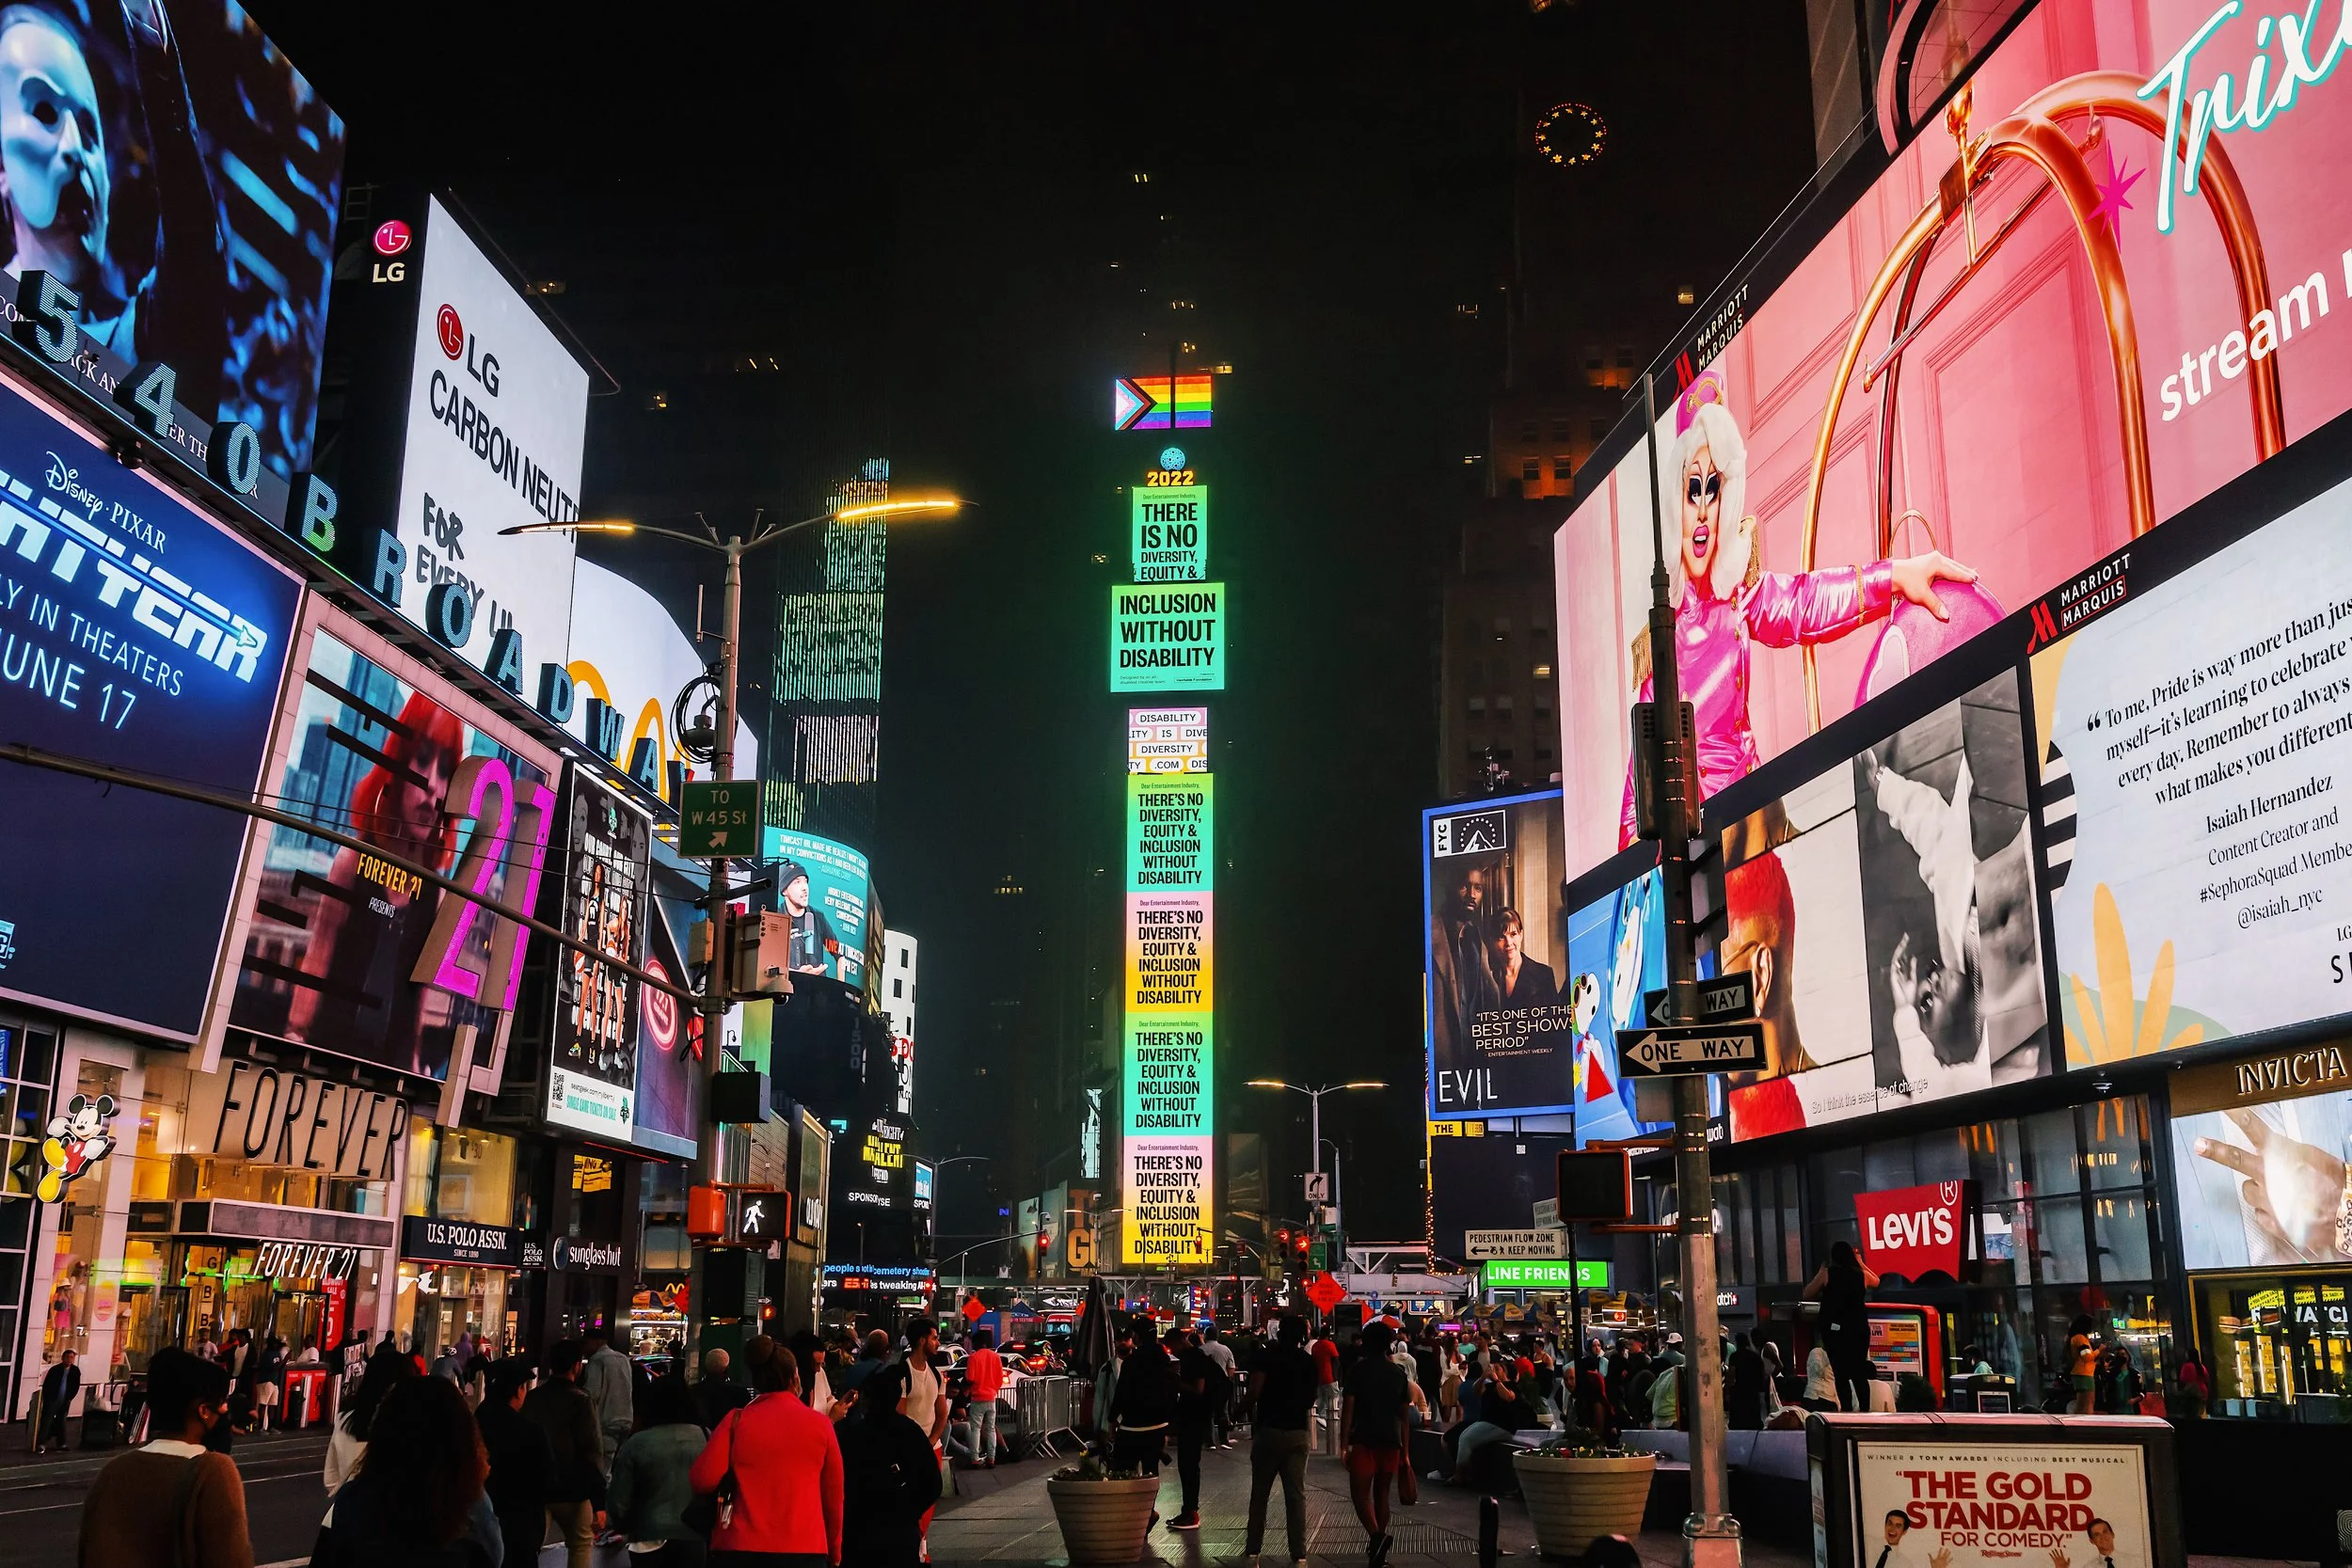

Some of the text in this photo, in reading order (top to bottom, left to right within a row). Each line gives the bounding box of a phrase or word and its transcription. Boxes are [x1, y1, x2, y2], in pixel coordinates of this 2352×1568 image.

[2137, 0, 2352, 234] Trix
[373, 262, 405, 283] LG
[1697, 284, 1748, 351] MARRIOTT
[1698, 313, 1743, 372] MARQUIS
[2160, 270, 2329, 421] stream
[467, 333, 500, 398] LG
[429, 370, 519, 490] CARBON
[1147, 470, 1194, 487] 2022
[1141, 502, 1198, 522] THERE
[110, 501, 167, 554] PIXAR
[424, 492, 464, 561] FOR
[1141, 523, 1198, 548] IS NO
[1141, 550, 1198, 563] DIVERSITY,
[1140, 564, 1198, 581] EQUITY &
[2061, 553, 2131, 607] MARRIOTT
[1120, 594, 1216, 614] INCLUSION
[2062, 578, 2126, 628] MARQUIS
[1120, 620, 1216, 642] WITHOUT
[29, 593, 184, 697] IN THEATERS
[1120, 647, 1215, 668] DISABILITY
[2106, 598, 2352, 729] To me, Pride is way more than jus
[0, 627, 136, 730] UNE 17
[2185, 641, 2346, 727] learning to celebrate
[1140, 713, 1196, 722] DISABILITY
[1162, 729, 1172, 737] IS
[2118, 676, 2350, 790] every day. Remember to always
[1141, 744, 1193, 753] DIVERSITY
[1154, 760, 1180, 769] .COM
[2155, 779, 2191, 806] what
[2195, 759, 2244, 794] makes
[2245, 745, 2276, 777] you
[710, 790, 729, 804] TO
[1137, 793, 1203, 806] THERE'S NO
[2206, 774, 2334, 834] Isaiah Hernandez
[691, 811, 746, 825] W 45 St
[1139, 809, 1201, 823] DIVERSITY,
[1144, 824, 1197, 838] EQUITY &
[1438, 823, 1448, 853] FYC
[2208, 806, 2340, 867] Content Creator and
[1139, 840, 1200, 853] INCLUSION
[1143, 856, 1197, 868] WITHOUT
[358, 852, 406, 895] FOREVER
[411, 756, 558, 1012] 21
[1137, 871, 1202, 884] DISABILITY
[2200, 842, 2352, 905] #SephoraSquad Membe
[368, 895, 396, 919] PRESENTS
[1136, 911, 1203, 924] THERE'S NO
[2237, 886, 2324, 931] @isaiah_nyc
[1138, 927, 1201, 941] DIVERSITY,
[1142, 942, 1197, 957] EQUITY &
[1138, 958, 1200, 972] INCLUSION
[1141, 974, 1197, 988] WITHOUT
[1136, 990, 1201, 1004] DISABILITY
[1706, 990, 1738, 1012] WAY
[1502, 1008, 1529, 1021] ONE
[1531, 1006, 1549, 1018] OF
[1549, 1004, 1572, 1016] THE
[1471, 1022, 1513, 1037] BEST
[1641, 1038, 1744, 1062] ONE WAY
[2234, 1047, 2347, 1096] INVICTA
[1438, 1068, 1498, 1110] EVIL
[1889, 1081, 1899, 1097] of
[1899, 1077, 1929, 1098] change
[214, 1059, 408, 1181] FOREVER
[1434, 1124, 1454, 1133] THE
[1135, 1156, 1202, 1170] THERE'S NO
[1136, 1173, 1200, 1188] DIVERSITY,
[1140, 1190, 1196, 1204] EQUITY &
[1136, 1206, 1200, 1220] INCLUSION
[427, 1223, 507, 1250] U.S. POLO ASSN.
[1139, 1223, 1196, 1237] WITHOUT
[1470, 1233, 1555, 1243] PEDESTRIAN FLOW ZONE
[453, 1248, 468, 1258] SINCE
[569, 1242, 621, 1270] sunglass hut
[1508, 1245, 1555, 1255] KEEP MOVING
[254, 1242, 358, 1280] FOREVER 21
[823, 1263, 858, 1277] people
[1487, 1267, 1520, 1279] LINE
[880, 1280, 917, 1291] tweaking
[1986, 1471, 2093, 1501] GOLD
[1906, 1501, 2094, 1531] STANDARD
[1941, 1531, 1979, 1547] FOR
